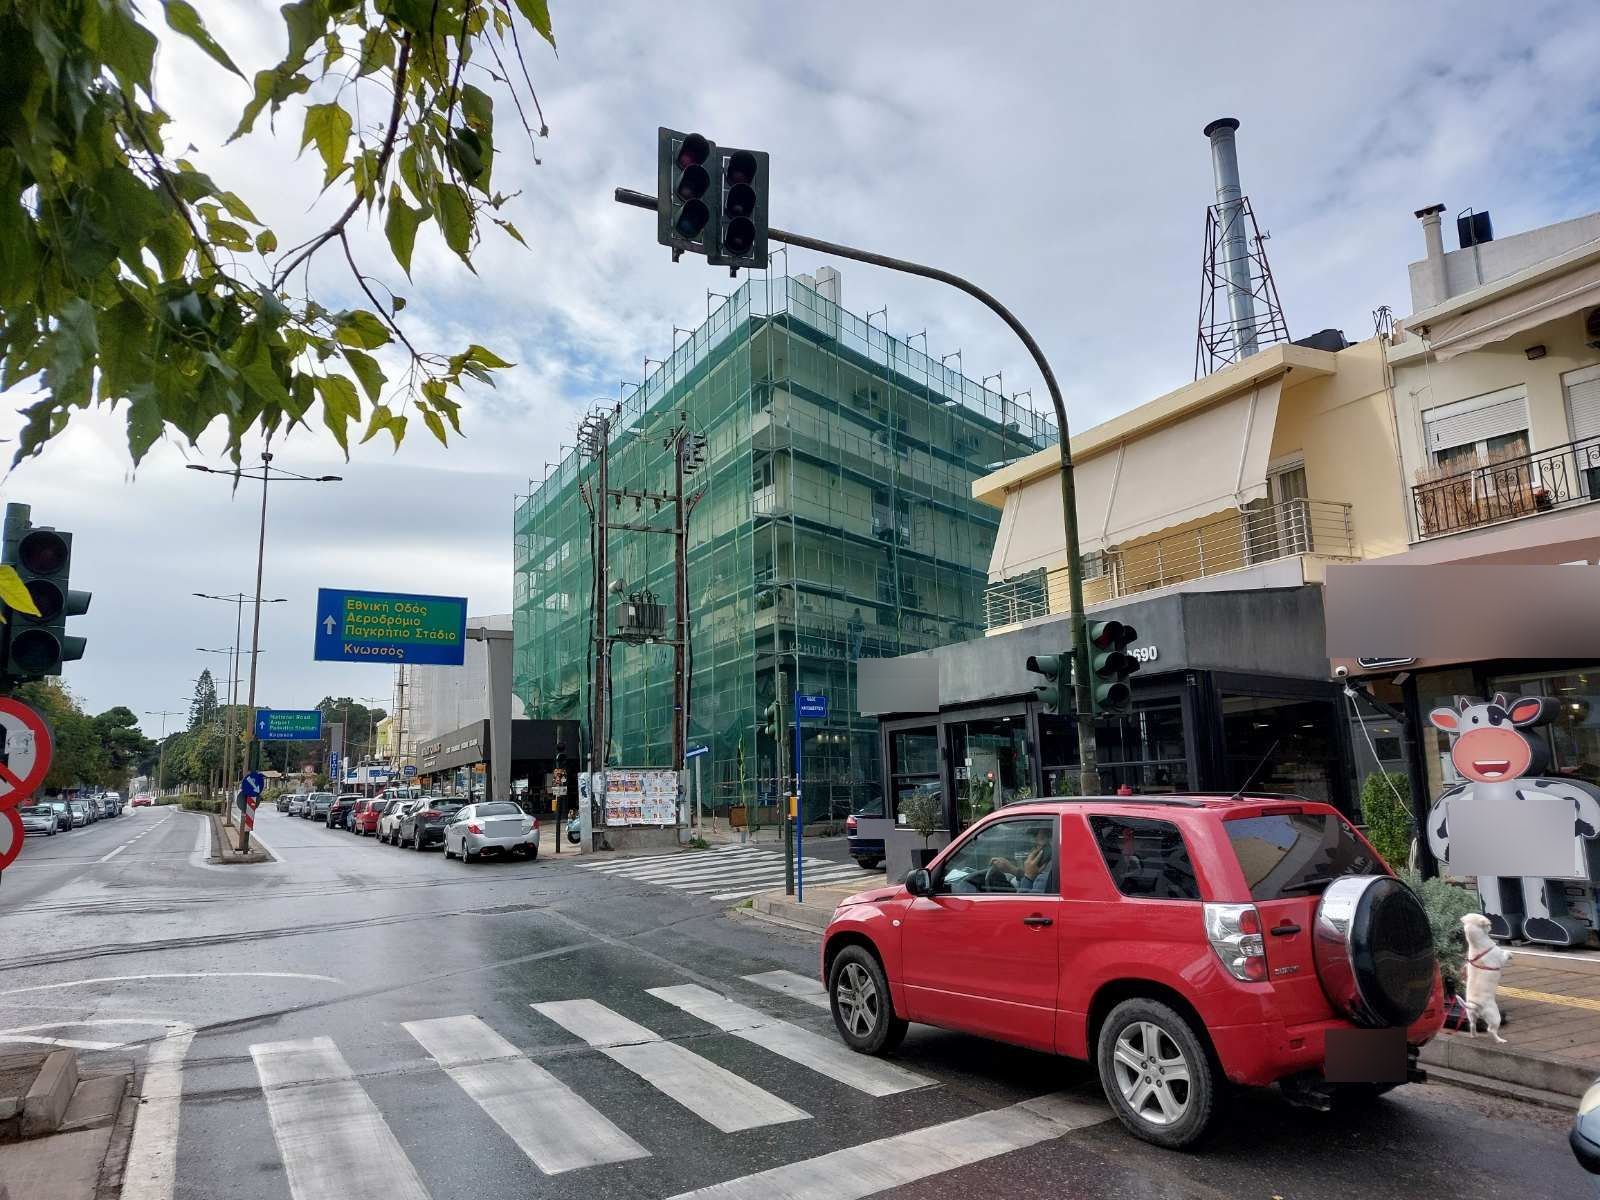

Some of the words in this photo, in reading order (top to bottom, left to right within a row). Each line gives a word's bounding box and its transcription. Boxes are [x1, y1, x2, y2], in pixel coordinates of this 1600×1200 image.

[346, 599, 389, 613] Εθνική
[394, 601, 428, 616] Οδός
[346, 612, 421, 627] Αεροδρόμιο
[344, 624, 410, 640] Παγκρήτιο
[415, 627, 456, 641] Στάδιο
[343, 643, 404, 659] Κνωσσός
